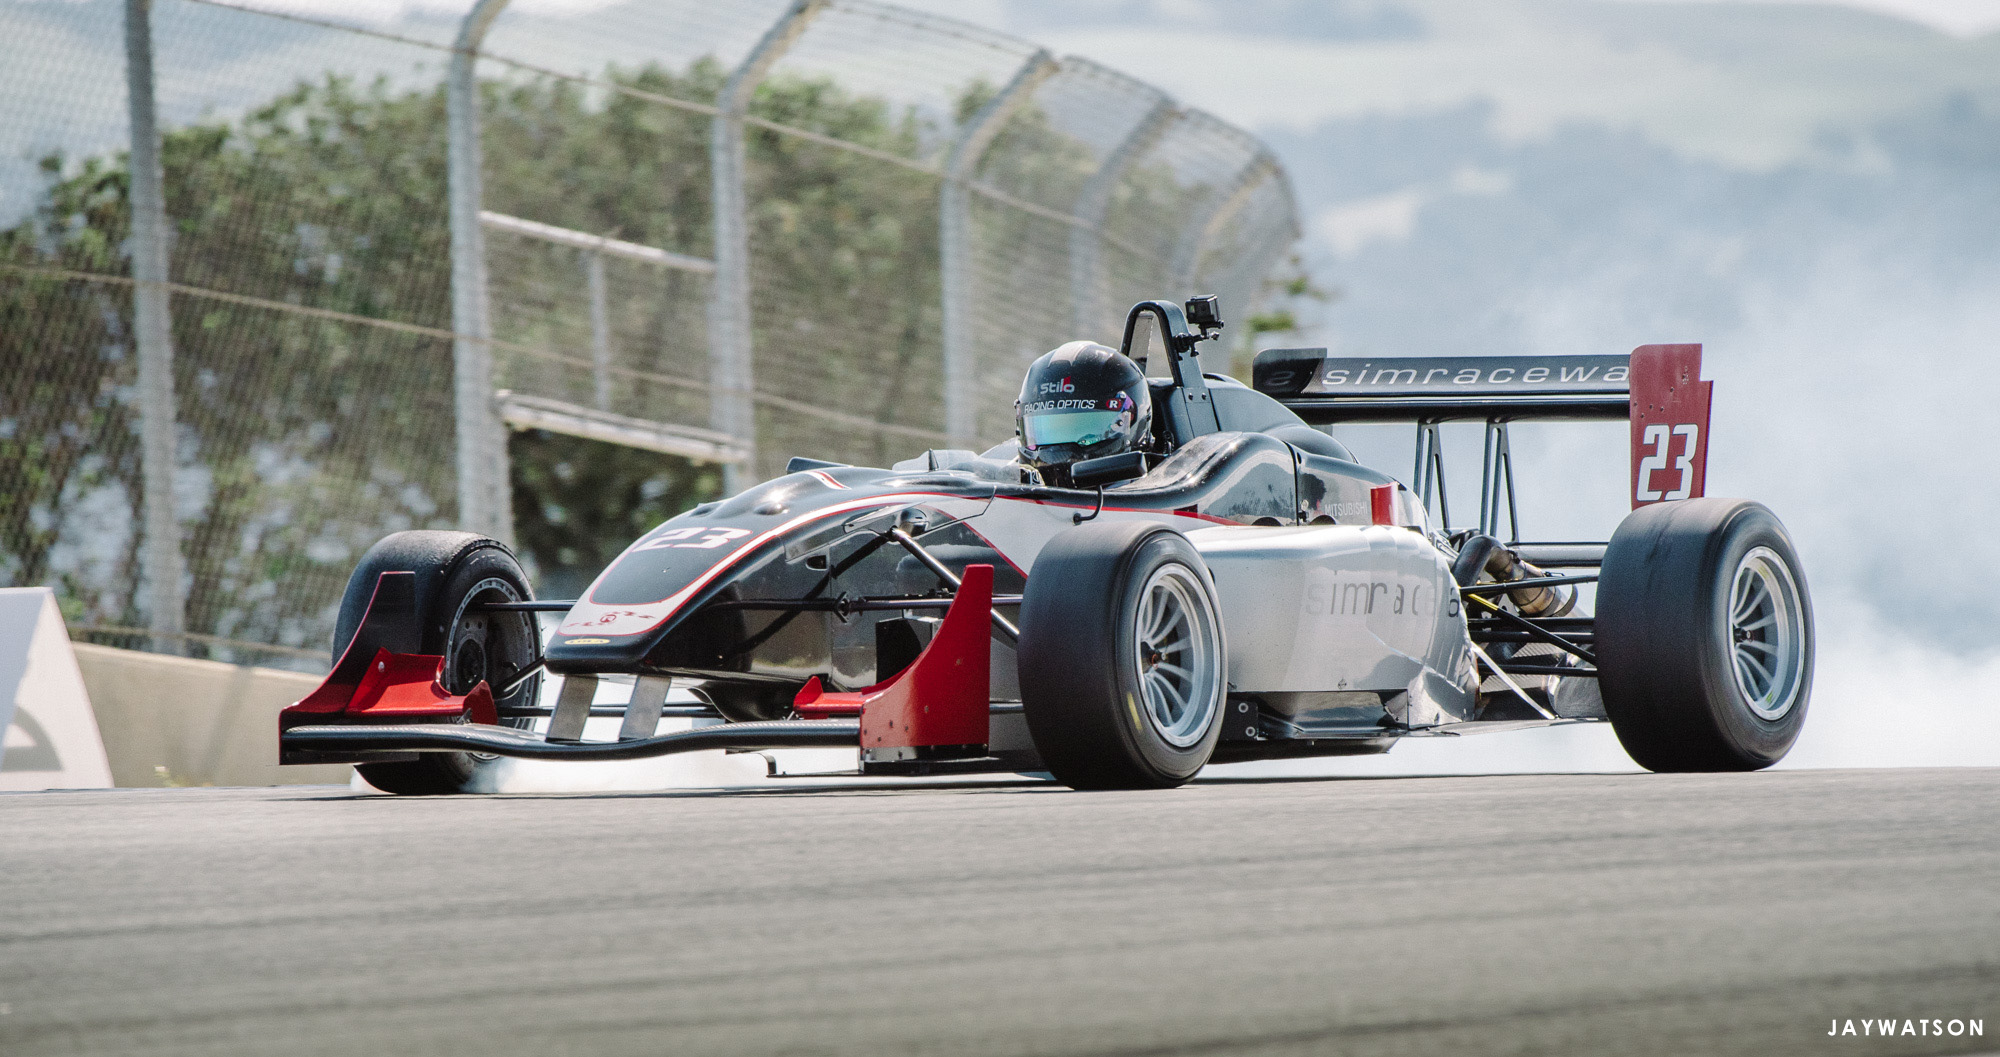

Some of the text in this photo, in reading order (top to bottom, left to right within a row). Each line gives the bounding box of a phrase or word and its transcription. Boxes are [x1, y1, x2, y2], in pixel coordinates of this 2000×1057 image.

[1040, 377, 1075, 394] stilo
[1024, 399, 1096, 413] RACING OPTICS
[1636, 423, 1699, 502] 23
[1324, 501, 1368, 516] MITSUBISHI
[631, 527, 753, 552] 23
